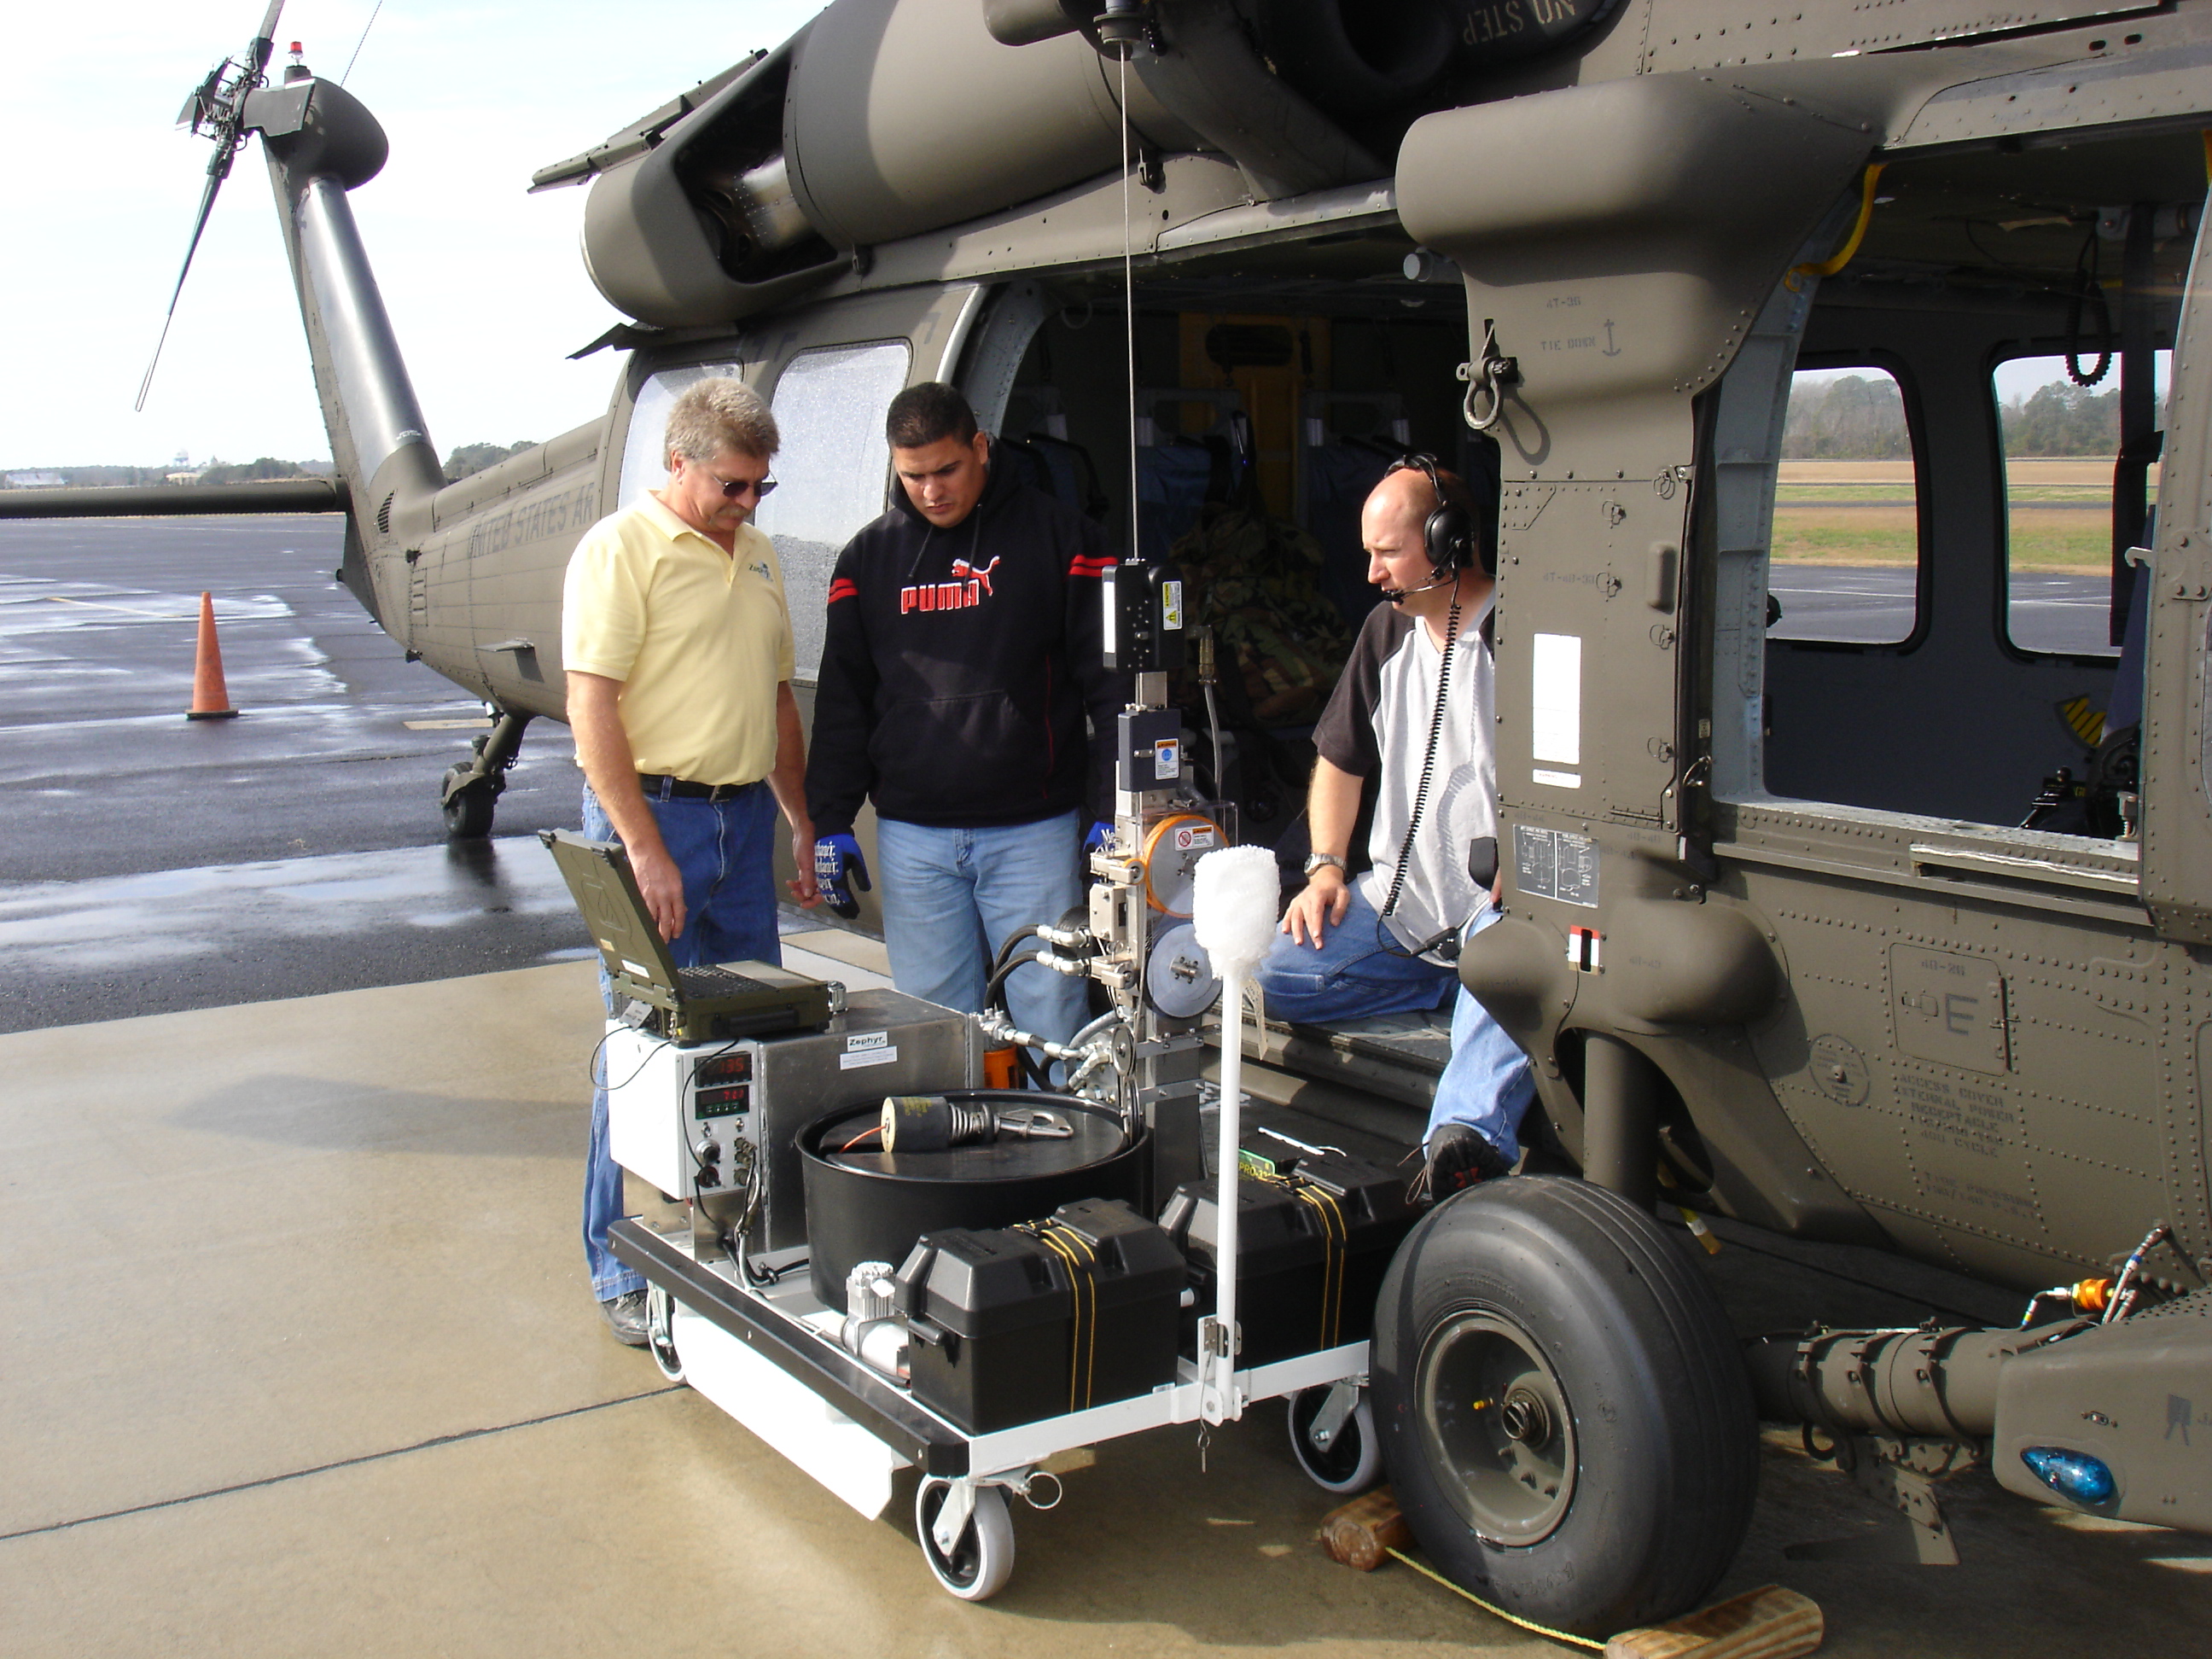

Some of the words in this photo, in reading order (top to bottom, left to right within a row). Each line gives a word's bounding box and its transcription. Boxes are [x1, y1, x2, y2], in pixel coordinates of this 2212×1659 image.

[1463, 3, 1524, 44] STEP
[1540, 340, 1561, 351] TIE
[468, 510, 513, 558] UNITED
[515, 491, 571, 544] STATES
[901, 579, 979, 614] PUMA
[1945, 993, 1978, 1035] E
[849, 1036, 883, 1046] Zephyr
[1901, 1073, 1949, 1094] ACCESS
[1959, 1087, 2003, 1108] COVER
[1912, 1102, 1999, 1132] RECEPTACLE
[1970, 1103, 2014, 1123] POWER
[1954, 1138, 1998, 1157] CYCLE
